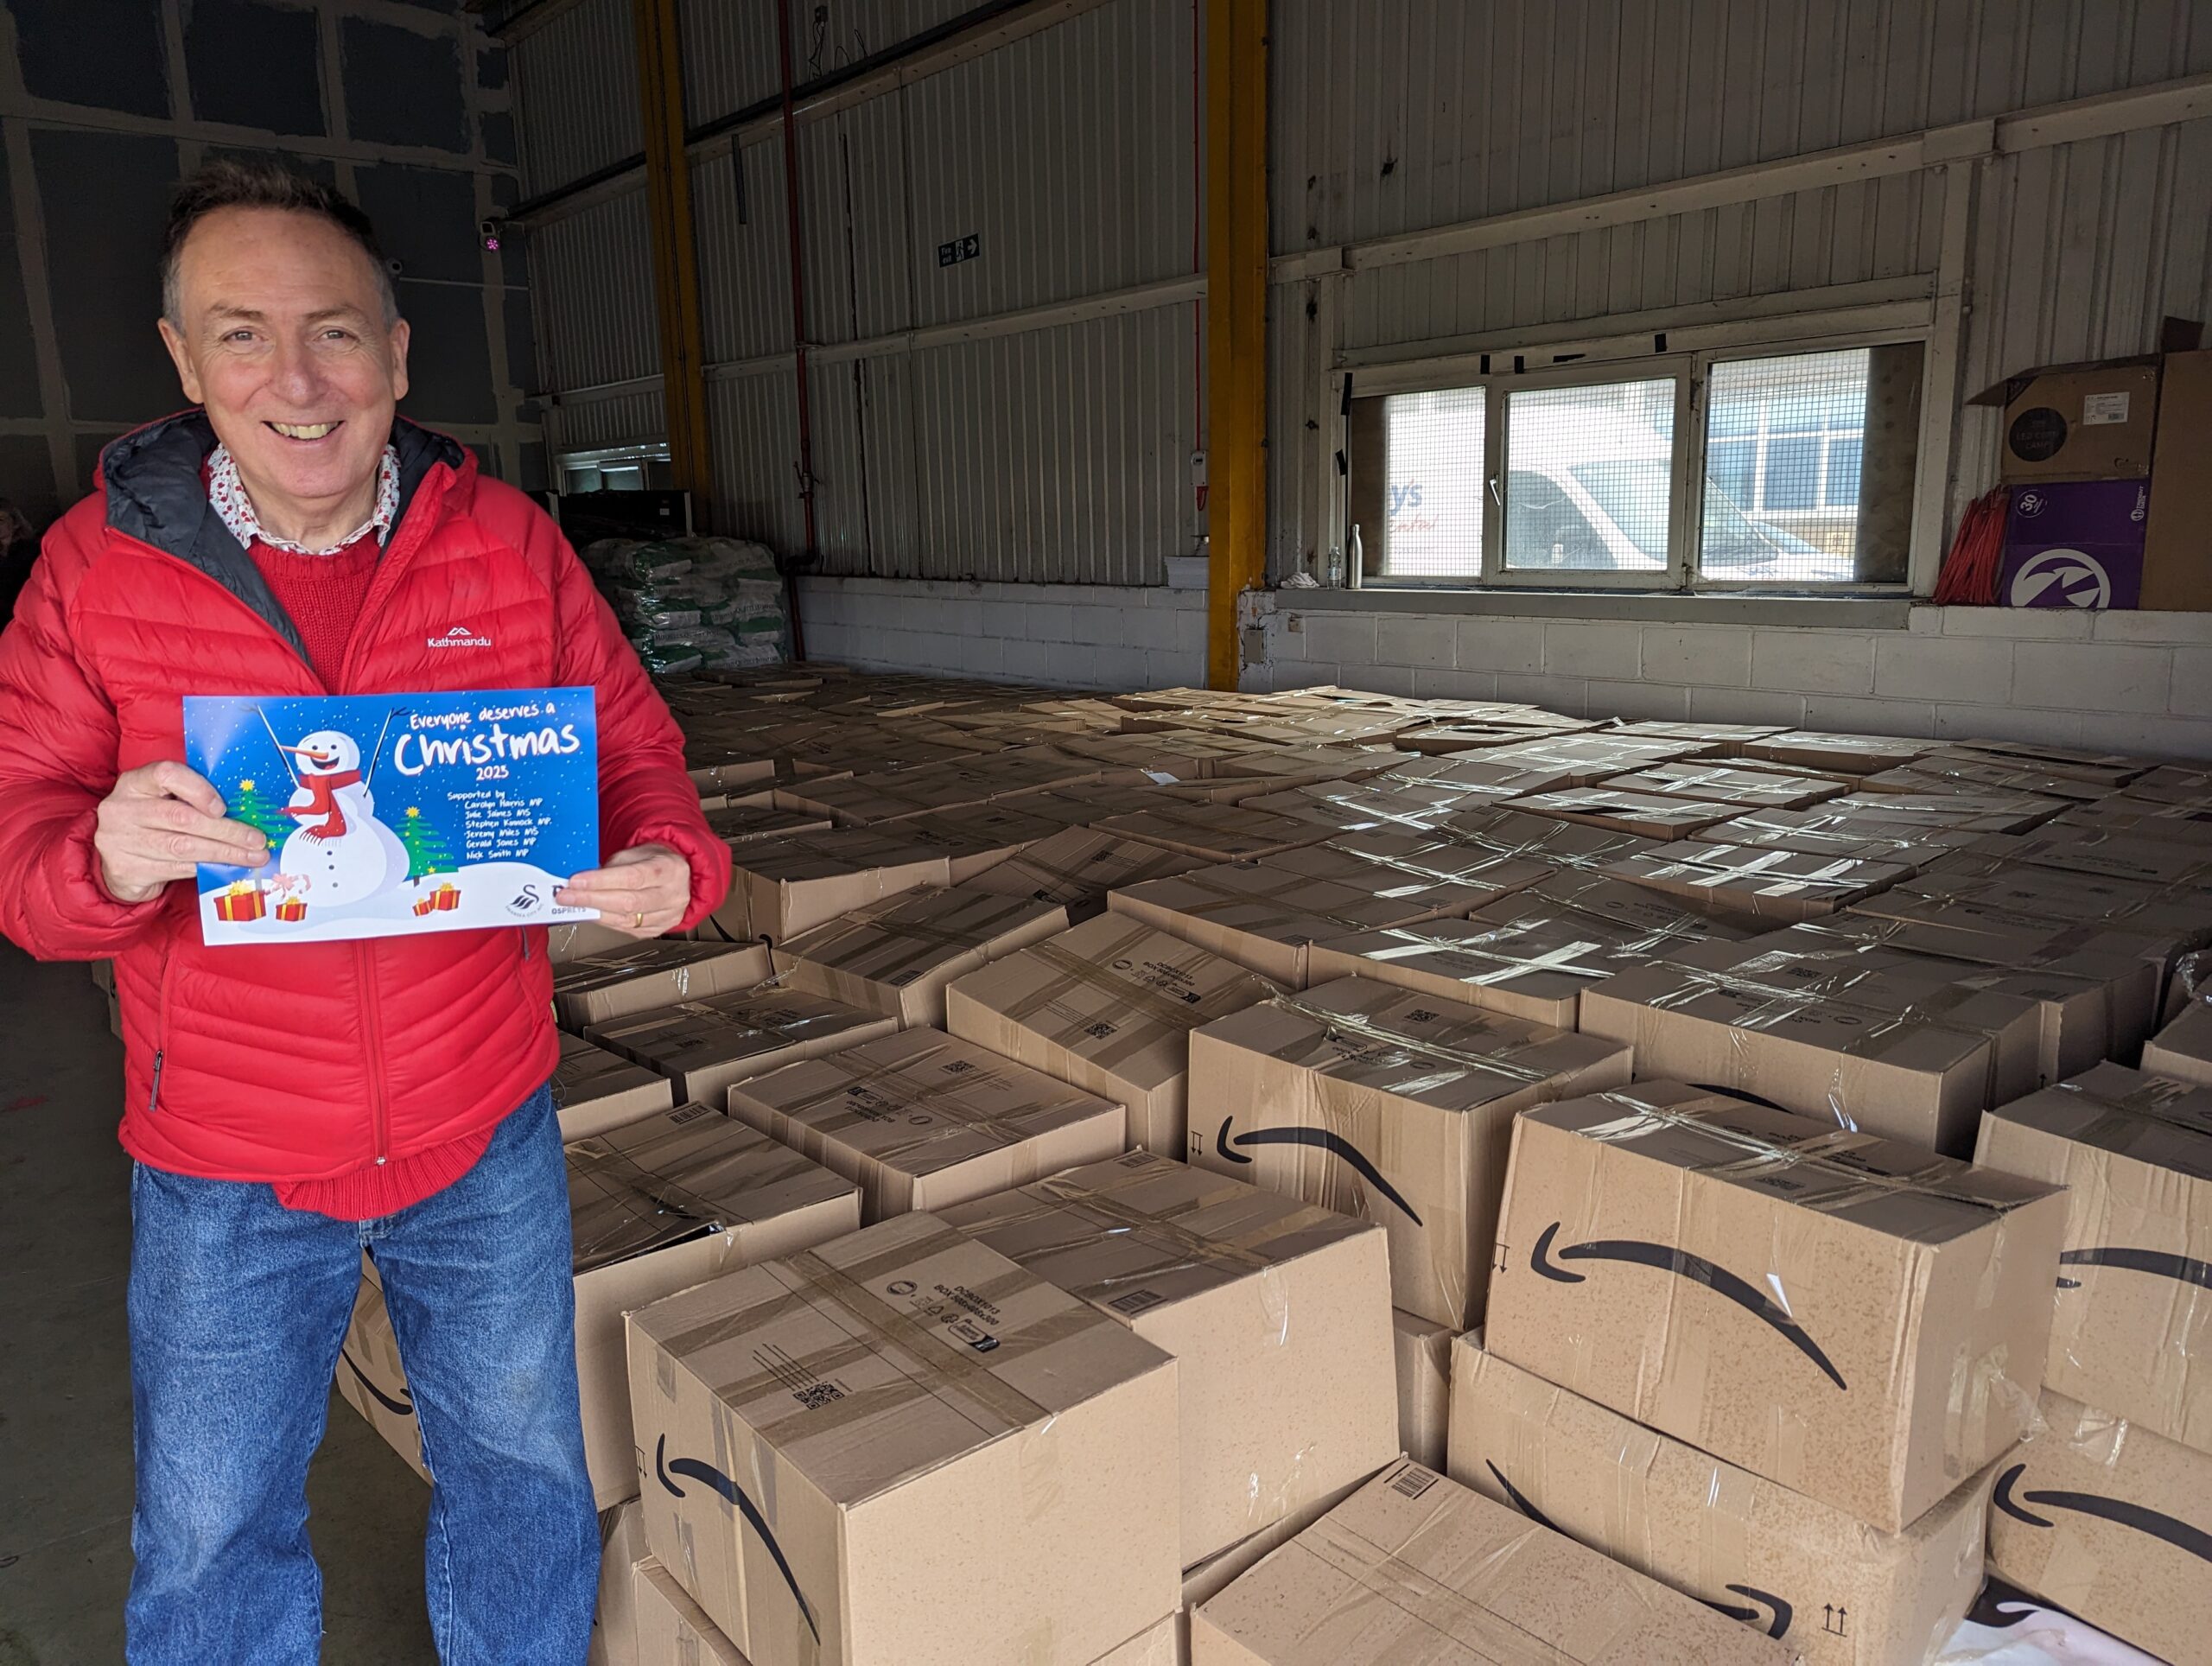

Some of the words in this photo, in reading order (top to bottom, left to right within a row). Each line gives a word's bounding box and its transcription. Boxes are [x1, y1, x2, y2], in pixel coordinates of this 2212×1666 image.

[2020, 494, 2037, 512] 30
[427, 636, 492, 648] Kathmandu
[410, 711, 472, 730] Everyone
[478, 704, 540, 722] deserves
[545, 703, 556, 715] a
[394, 723, 581, 776] Christmas
[475, 765, 510, 781] 2023
[447, 790, 492, 801] Supported
[495, 790, 506, 799] by
[464, 800, 496, 811] Carolyn
[499, 798, 525, 808] Harris
[529, 798, 543, 807] MP
[486, 809, 512, 818] James
[516, 808, 532, 817] MS
[465, 819, 499, 830] Stephen
[503, 818, 534, 827] Kinnock
[537, 817, 551, 826] MP
[466, 829, 495, 840] Jeremy
[499, 827, 520, 836] Miles
[524, 826, 539, 836] MS
[466, 840, 493, 849] Gerald
[496, 838, 519, 848] Jones
[523, 836, 537, 847] MP
[466, 850, 484, 861] Nick
[487, 849, 512, 860] Smith
[515, 848, 530, 857] MP
[934, 1284, 955, 1297] BOX
